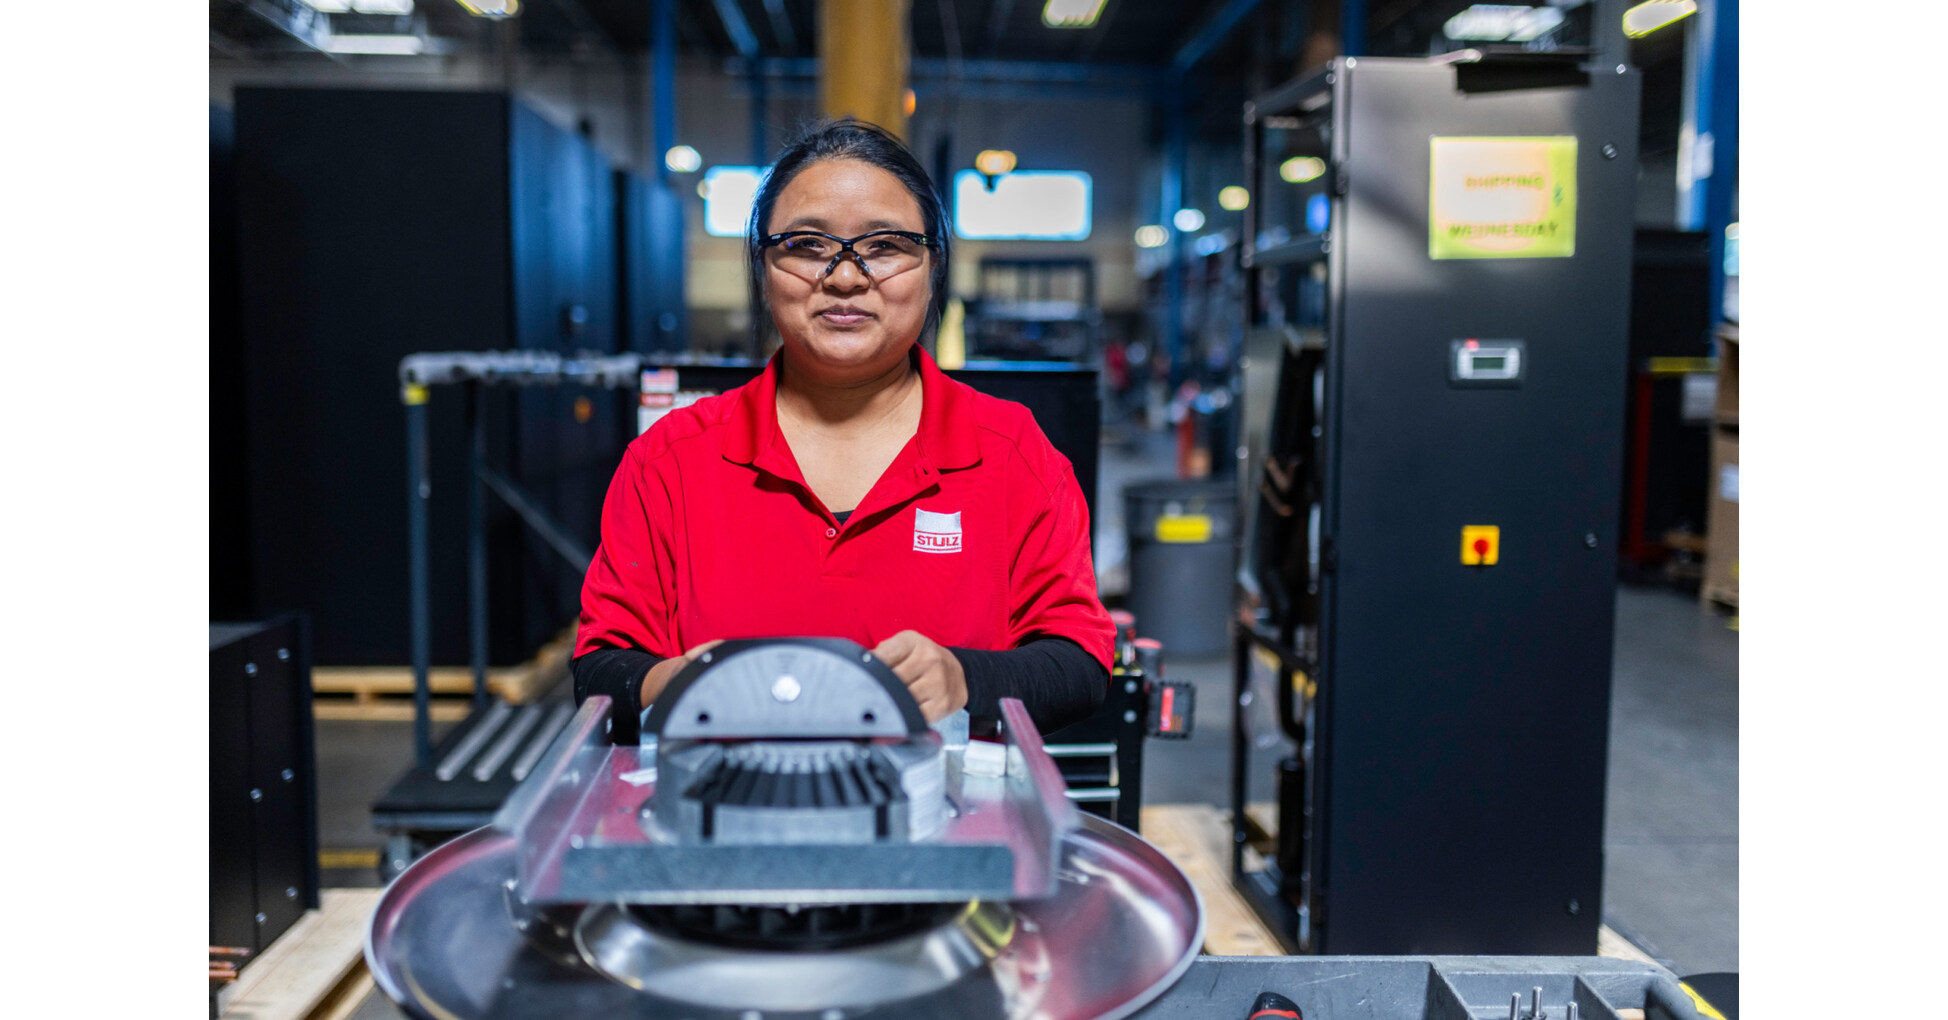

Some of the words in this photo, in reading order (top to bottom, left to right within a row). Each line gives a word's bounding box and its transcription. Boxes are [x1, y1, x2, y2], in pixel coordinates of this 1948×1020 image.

[1464, 175, 1545, 189] SHIPPING
[1449, 222, 1558, 238] WEDNESDAY
[916, 535, 959, 547] STULZ
